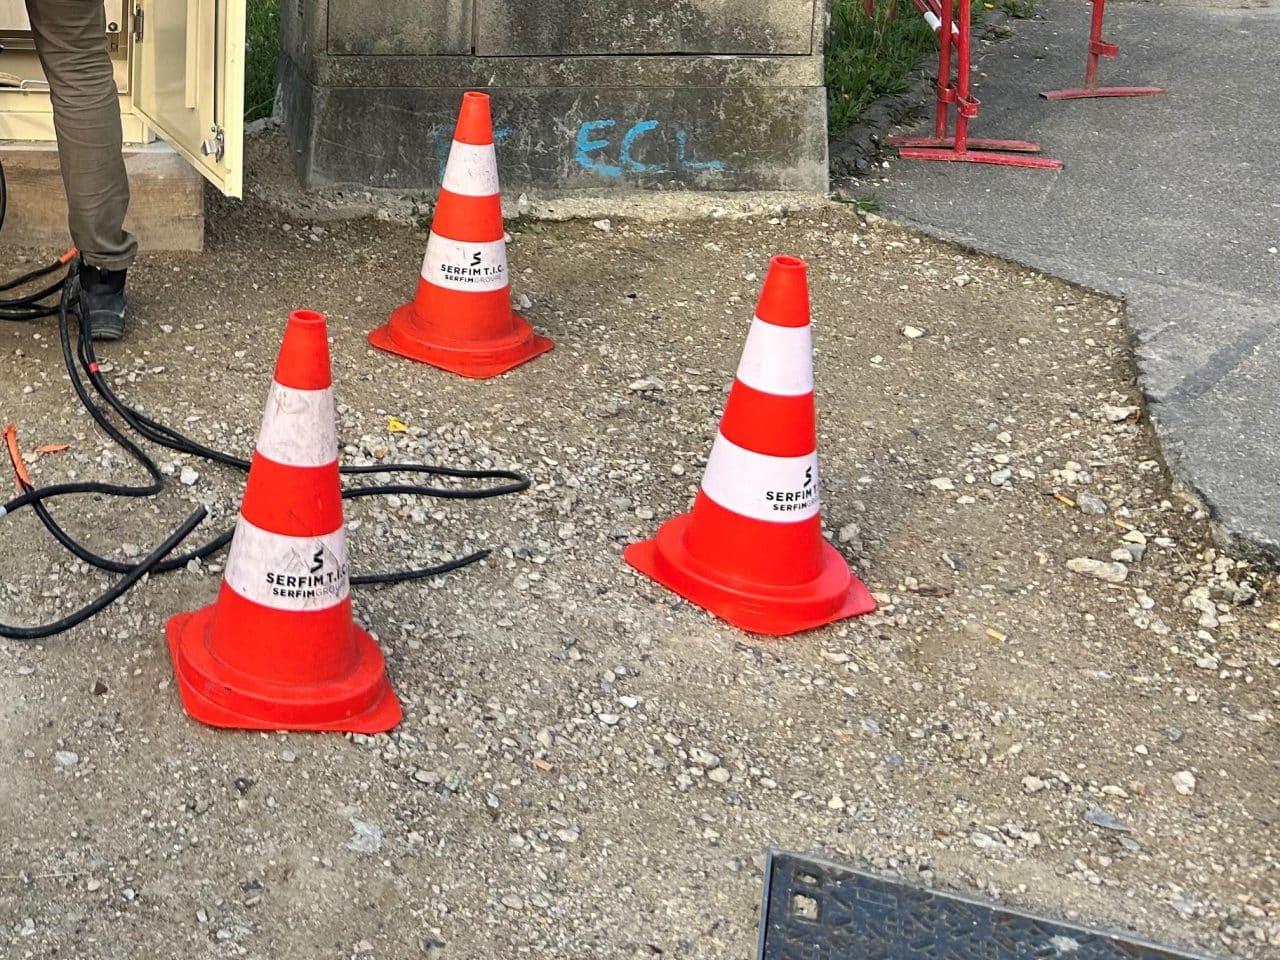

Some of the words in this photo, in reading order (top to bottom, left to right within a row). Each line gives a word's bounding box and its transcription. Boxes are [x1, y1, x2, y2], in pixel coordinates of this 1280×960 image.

[441, 264, 481, 276] SERFIM
[766, 488, 812, 502] SERFIM
[266, 572, 324, 588] SERFIM
